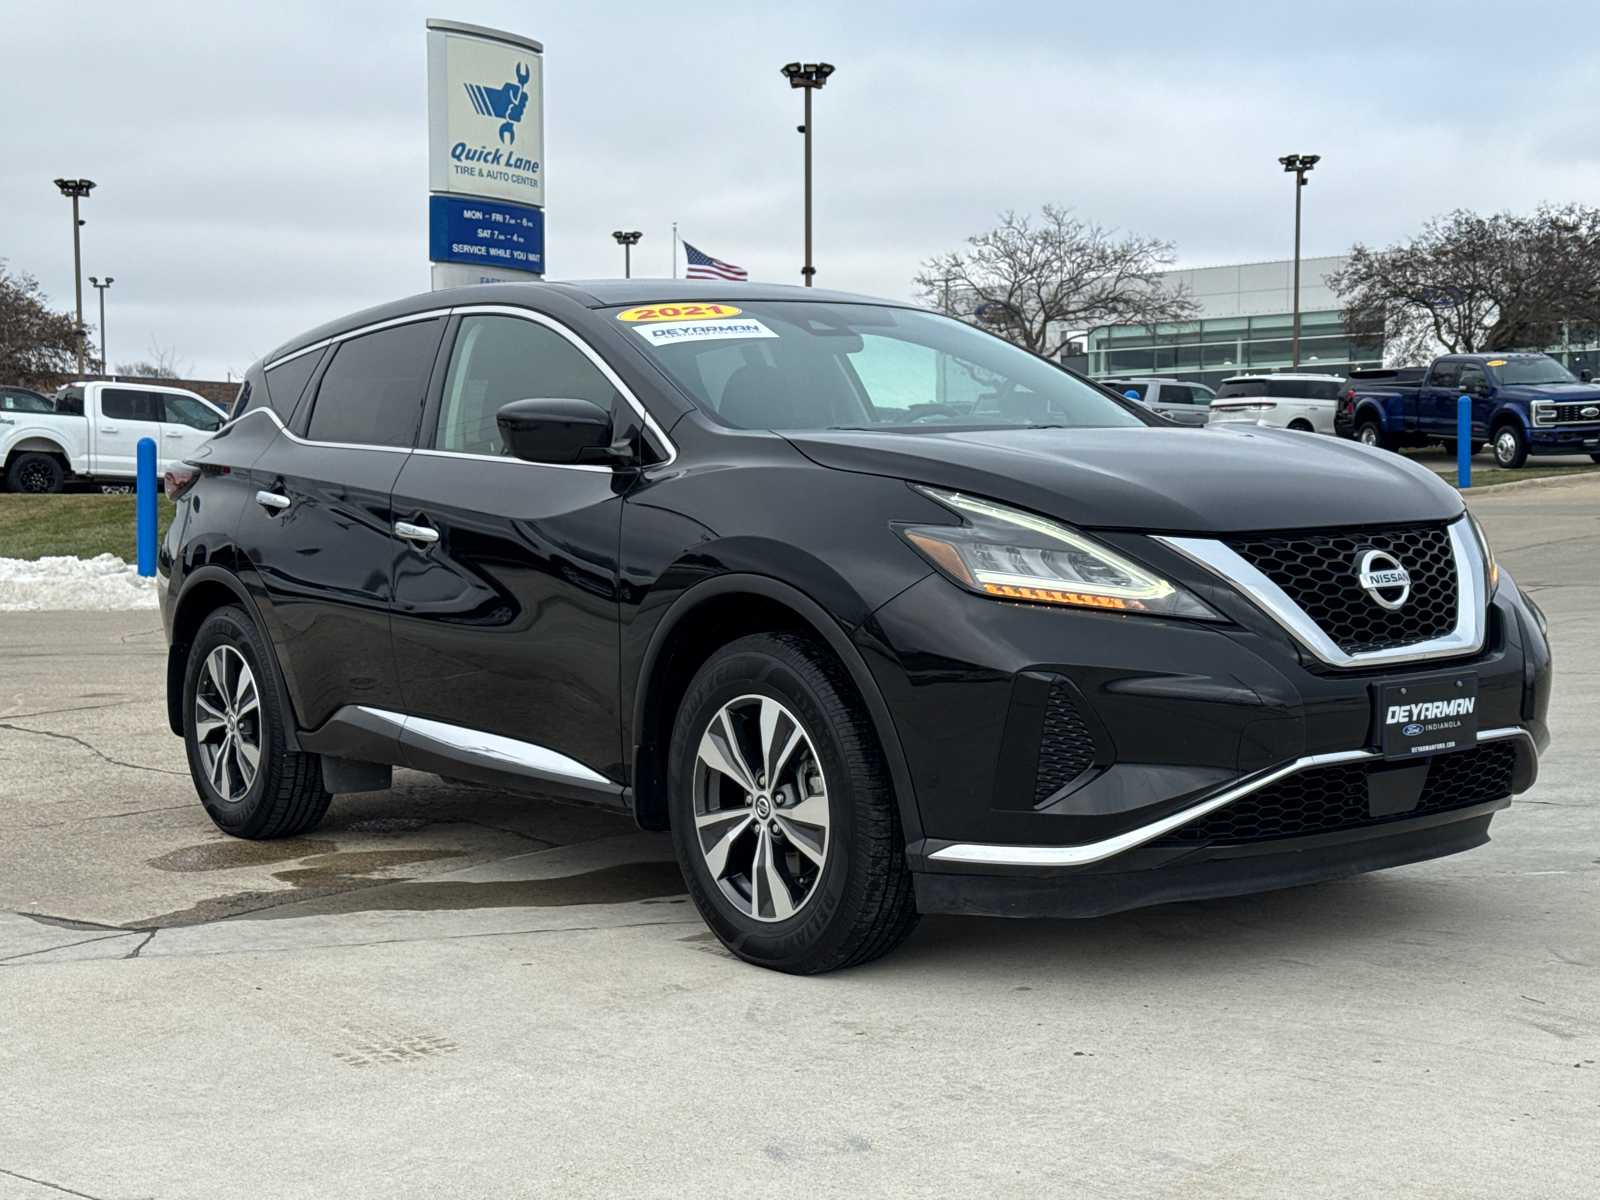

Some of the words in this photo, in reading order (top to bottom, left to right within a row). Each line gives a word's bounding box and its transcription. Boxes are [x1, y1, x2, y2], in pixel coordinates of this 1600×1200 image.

[451, 142, 504, 165] Quick
[504, 151, 540, 173] Lane
[454, 165, 476, 176] TIRE
[477, 168, 484, 178] &
[486, 170, 510, 182] AUTO
[511, 174, 539, 188] CENTER
[463, 209, 483, 220] MON
[491, 213, 504, 223] FRI
[477, 228, 492, 239] SAT
[452, 243, 487, 255] SERVICE
[489, 247, 511, 258] WHILE
[513, 250, 527, 260] YOU
[527, 253, 541, 262] WAIT
[634, 305, 725, 320] 2021
[652, 325, 760, 337] DEYARMAN
[1370, 573, 1409, 584] NISSAN
[1386, 697, 1475, 724] DEYARMAN
[1405, 724, 1421, 735] Ford
[1425, 720, 1461, 731] INDIANOLA
